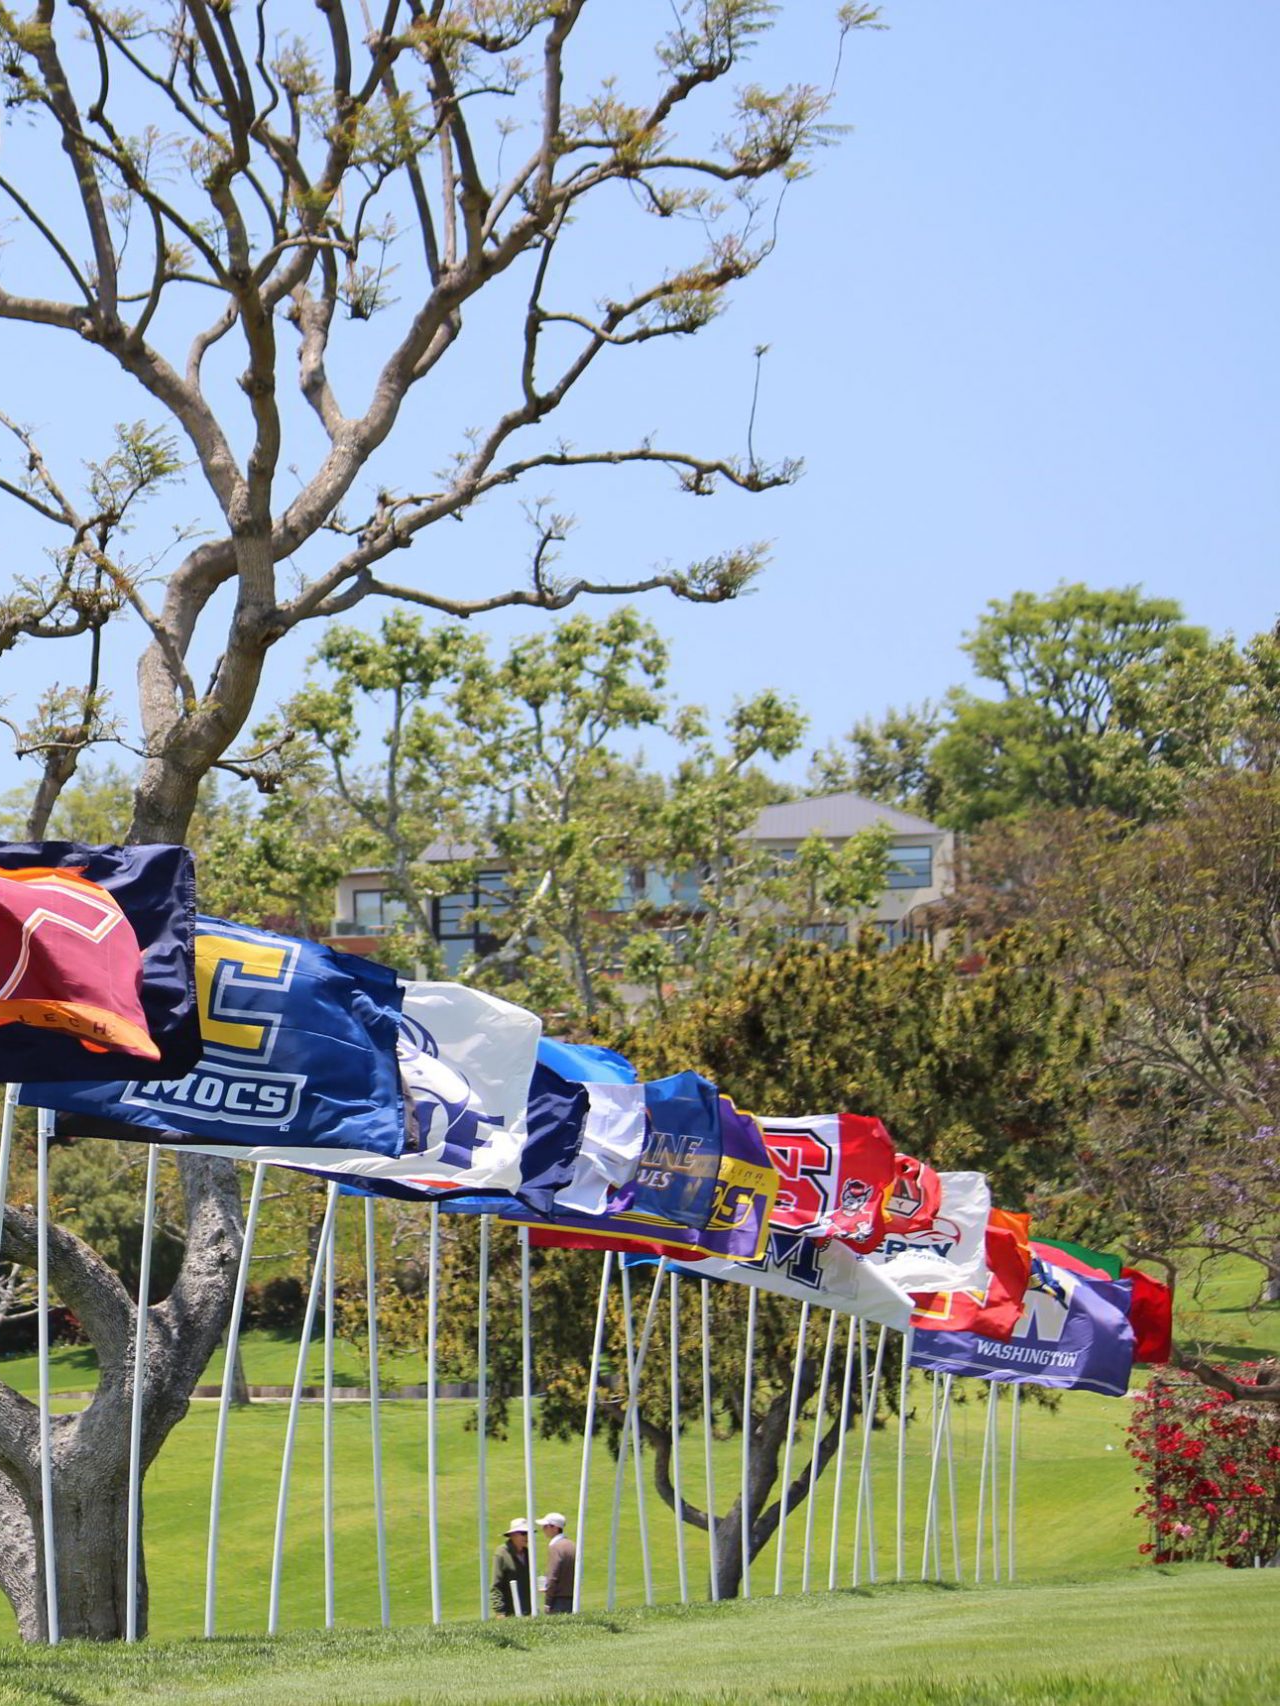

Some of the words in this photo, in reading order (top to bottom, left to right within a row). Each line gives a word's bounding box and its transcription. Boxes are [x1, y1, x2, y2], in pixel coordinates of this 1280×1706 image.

[141, 1073, 287, 1113] MOCS
[640, 1131, 704, 1171] INE
[977, 1340, 1078, 1367] WASHINGTON
